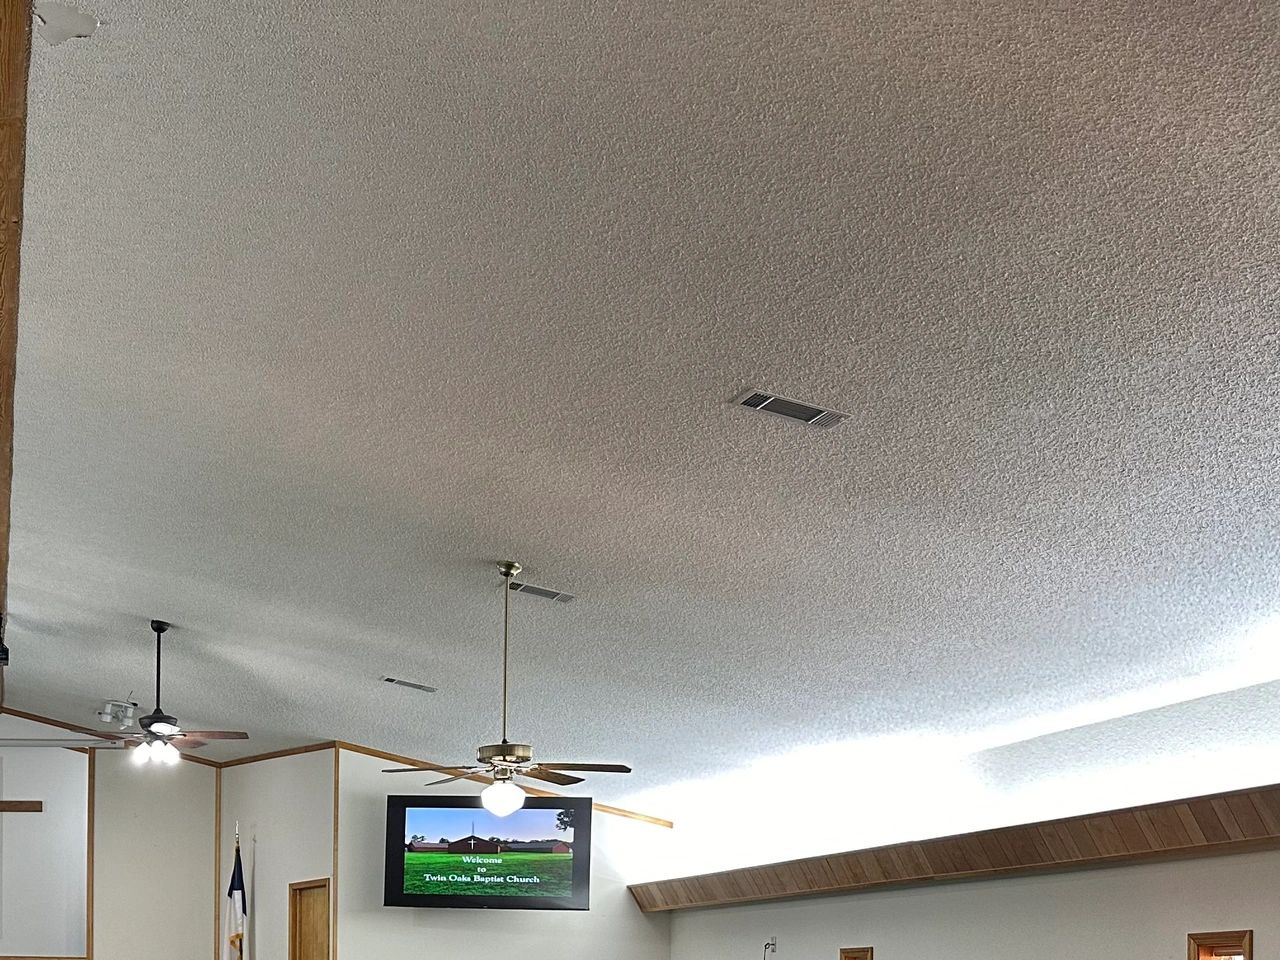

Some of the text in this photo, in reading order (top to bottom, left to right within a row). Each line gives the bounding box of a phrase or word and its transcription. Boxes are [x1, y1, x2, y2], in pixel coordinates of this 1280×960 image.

[461, 855, 503, 864] Welcome
[423, 873, 540, 884] Twin Oaks Baptist Church
